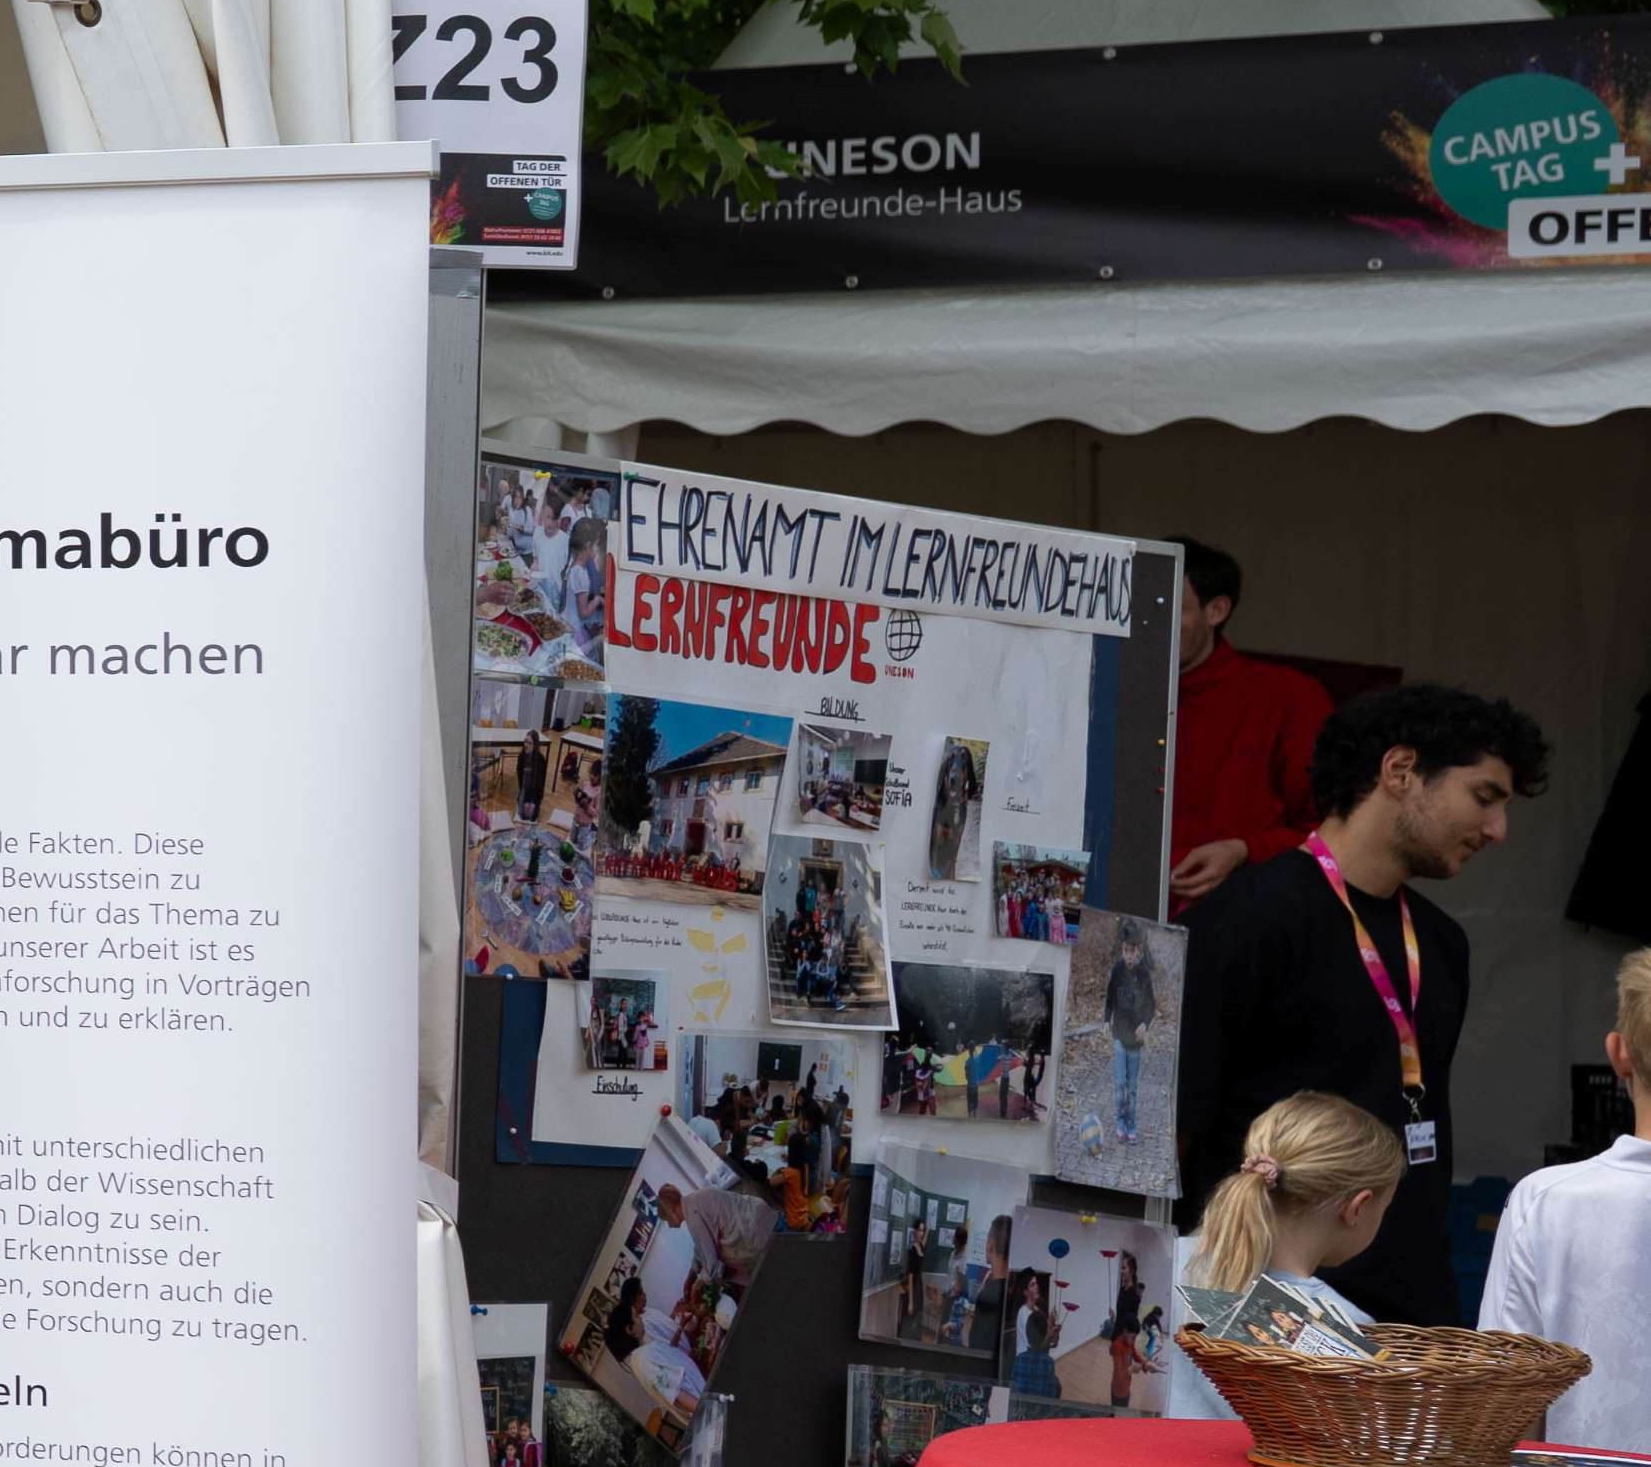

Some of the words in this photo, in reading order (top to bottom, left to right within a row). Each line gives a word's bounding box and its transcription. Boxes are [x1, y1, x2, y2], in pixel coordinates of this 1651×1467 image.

[1443, 109, 1602, 166] CAMPUS
[516, 162, 537, 171] TAG
[539, 162, 561, 172] DER
[1490, 152, 1566, 192] TAG
[490, 176, 539, 187] OFFENEN
[541, 176, 562, 187] TÜR
[625, 476, 841, 585] EHRENAMT
[841, 514, 886, 591] IM
[883, 523, 1134, 624] LERNFREUNDEHAUS
[606, 553, 881, 685] LERNFREUNDE
[51, 632, 262, 675] machen
[30, 831, 122, 854] Fakten.
[135, 832, 204, 855] Diese
[3, 867, 159, 889] Bewusstsein
[170, 874, 200, 890] zu
[48, 900, 86, 924] für
[96, 901, 139, 924] das
[148, 902, 238, 926] Thema
[249, 910, 279, 926] zu
[98, 936, 179, 960] Arbeit
[190, 938, 218, 960] ist
[228, 945, 254, 961] es
